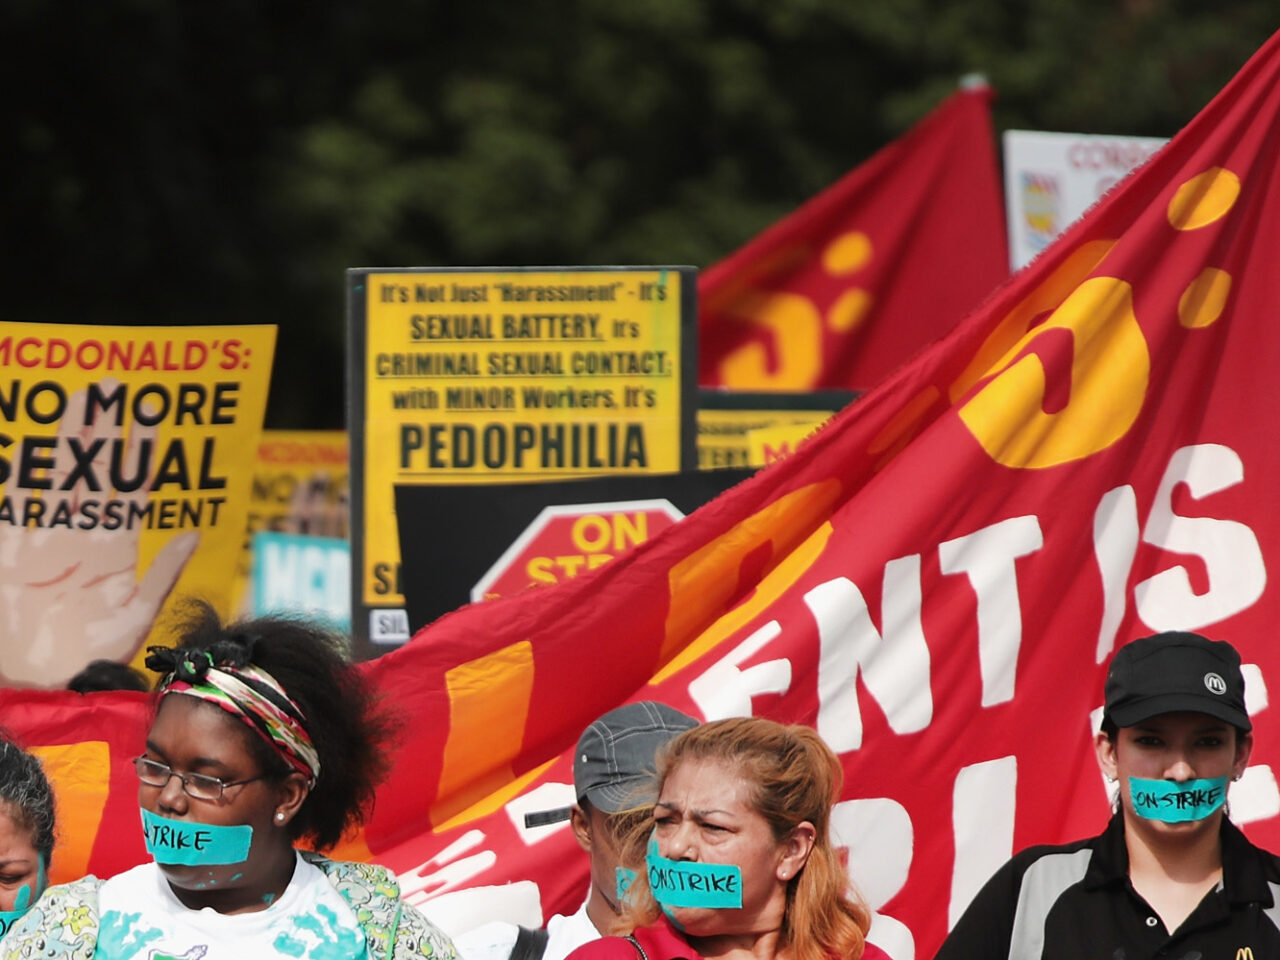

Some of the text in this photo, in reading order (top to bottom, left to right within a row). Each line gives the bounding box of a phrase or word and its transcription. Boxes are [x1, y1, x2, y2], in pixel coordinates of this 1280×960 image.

[414, 282, 445, 303] Not
[450, 282, 488, 303] Just
[410, 314, 495, 339] SEXUAL
[375, 352, 480, 376] CRIMINAL
[487, 352, 565, 375] SEXUAL
[83, 380, 241, 427] MORE
[391, 386, 440, 410] with
[445, 387, 517, 410] MINOR
[399, 423, 650, 470] PEDOPHILIA
[572, 511, 649, 552] ON
